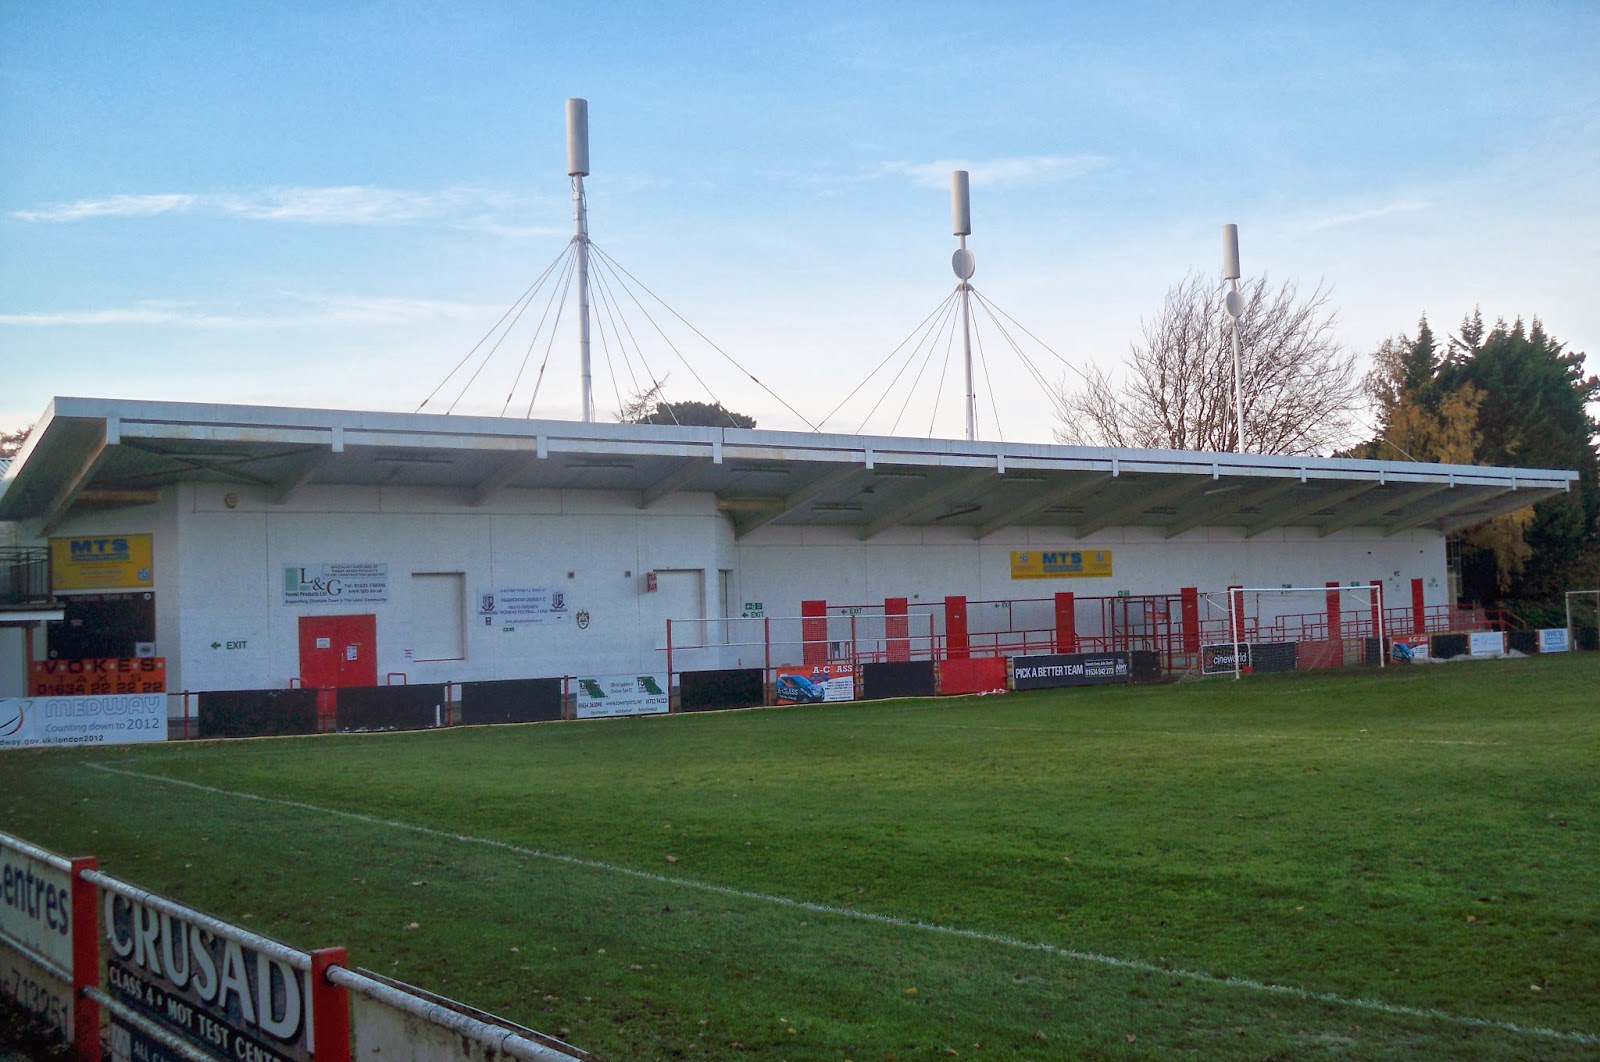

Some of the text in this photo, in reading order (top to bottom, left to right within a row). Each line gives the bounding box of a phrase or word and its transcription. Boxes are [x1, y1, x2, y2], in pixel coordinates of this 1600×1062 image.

[70, 538, 129, 552] MTS
[1042, 552, 1083, 564] MTS
[226, 641, 247, 650] EXIT
[44, 658, 155, 673] VOKES
[1015, 664, 1084, 679] PICK A BETTER TEAM
[37, 682, 163, 695] 01634 22 22 22
[45, 697, 160, 717] MEDWAY
[45, 717, 160, 733] Counting down to 2012
[104, 889, 315, 1054] CRUSAD
[109, 966, 143, 1000] CLASS
[167, 997, 193, 1027] MOT
[198, 1013, 230, 1049] TEST
[235, 1036, 282, 1062] CENT
